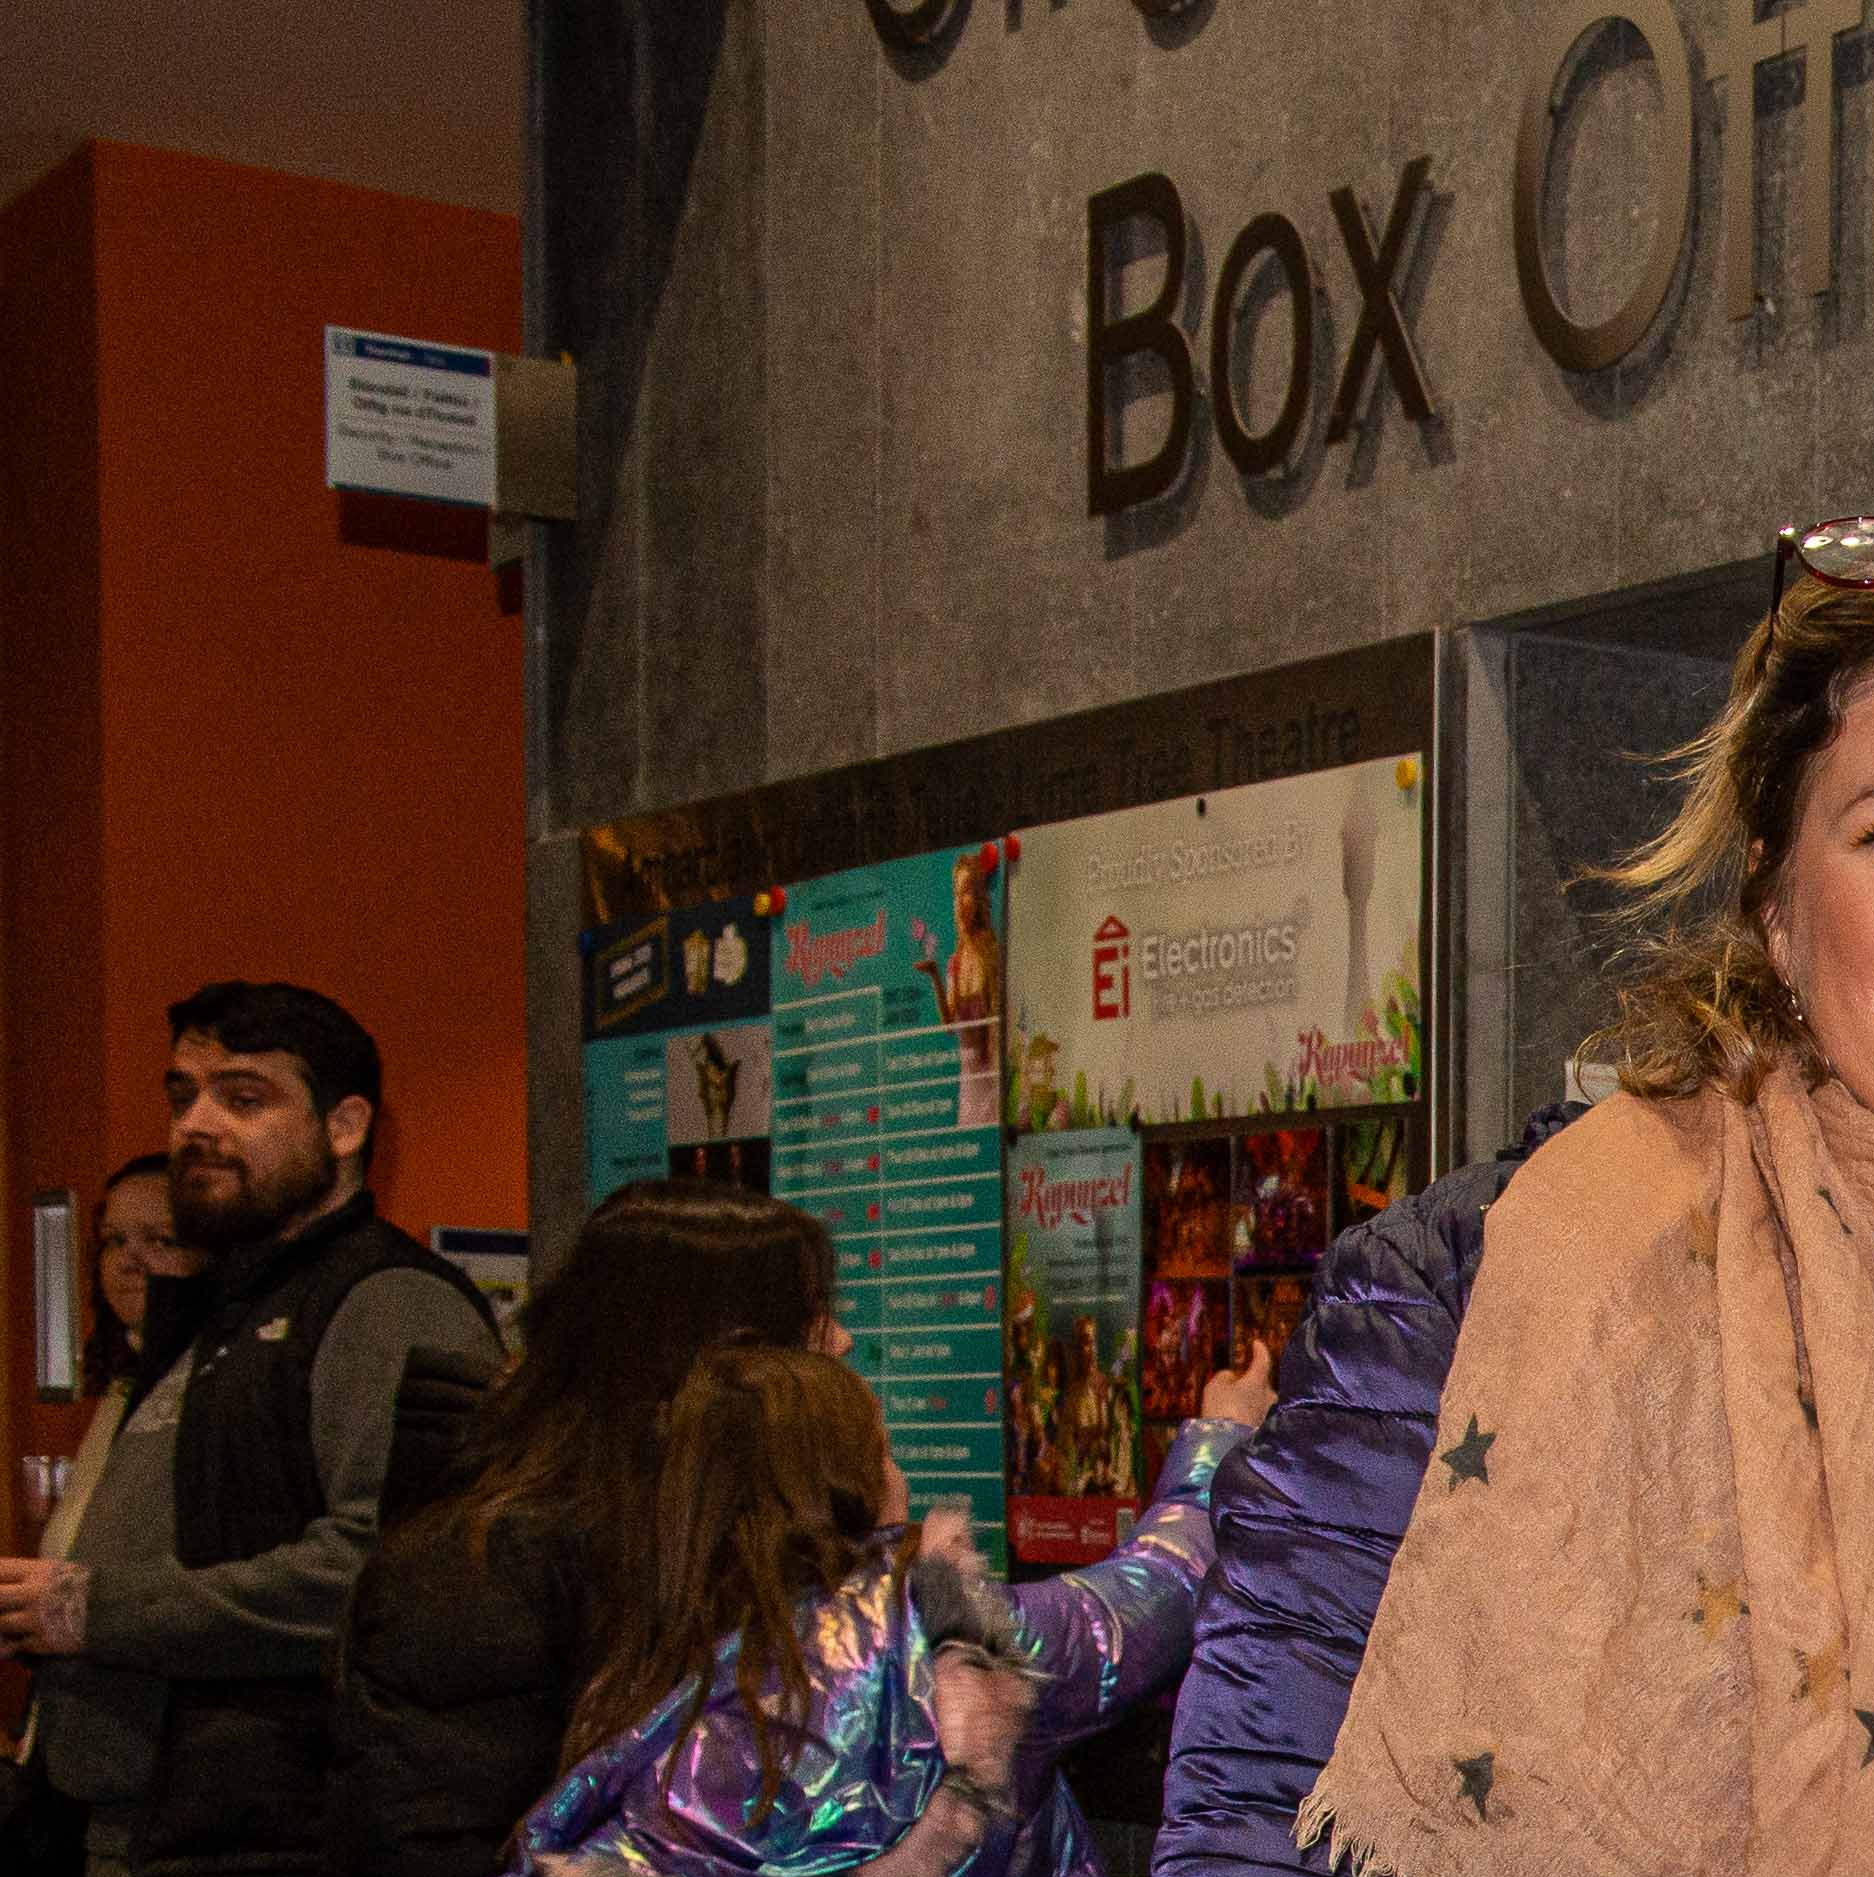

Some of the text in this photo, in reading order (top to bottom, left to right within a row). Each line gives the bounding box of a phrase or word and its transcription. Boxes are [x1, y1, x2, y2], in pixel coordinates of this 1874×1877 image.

[1087, 155, 1438, 516] Box
[1115, 736, 1199, 807] Tree
[1206, 702, 1360, 787] Theatre
[1141, 922, 1298, 981] Electronics
